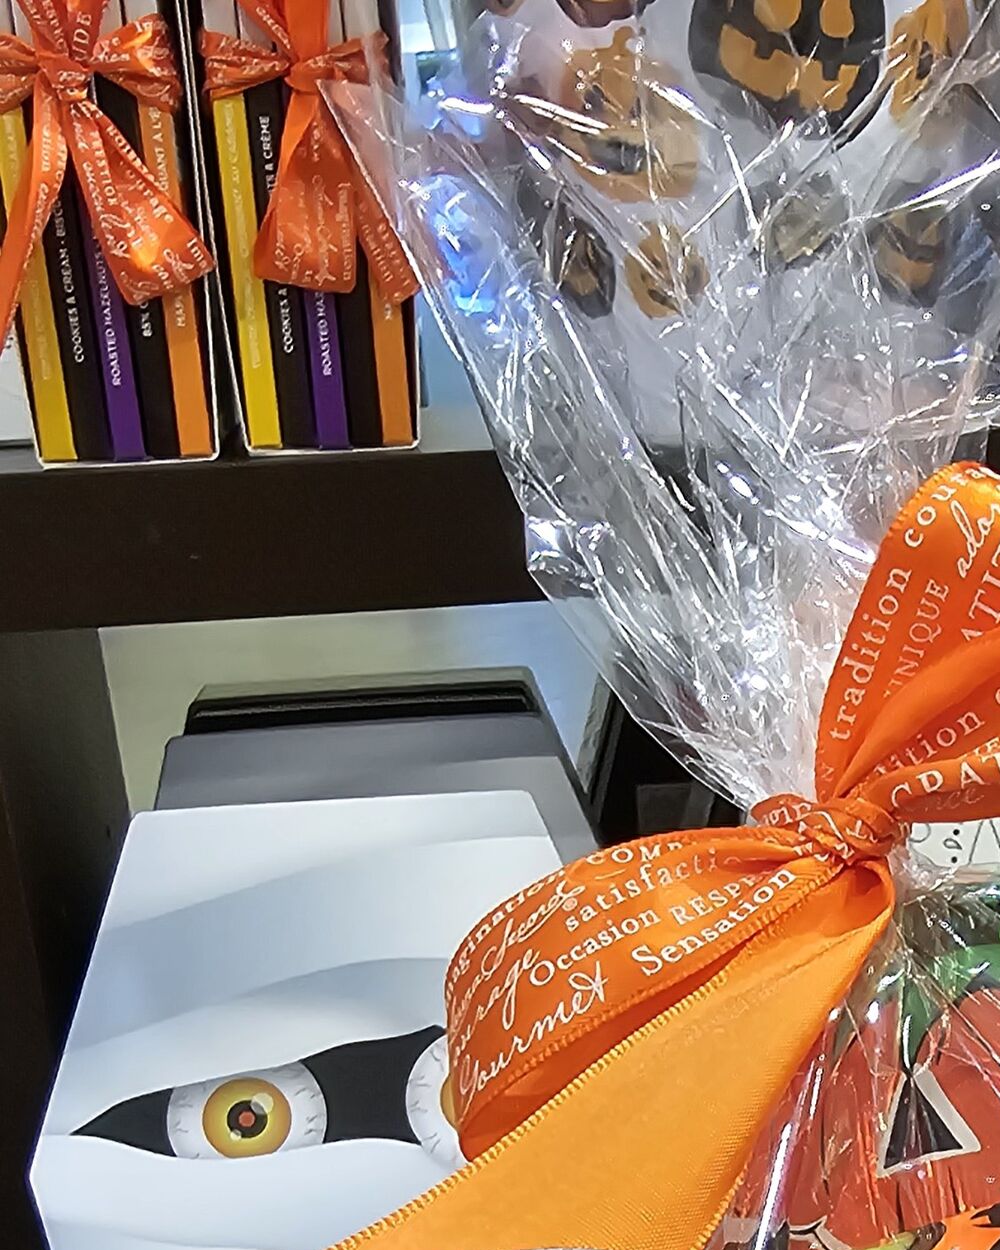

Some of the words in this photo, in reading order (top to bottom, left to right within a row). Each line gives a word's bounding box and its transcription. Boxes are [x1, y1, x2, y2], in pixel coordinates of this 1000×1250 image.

[58, 246, 75, 294] CREAM
[66, 307, 85, 364] COOKIES
[104, 329, 122, 387] ROASTED
[316, 319, 333, 377] ROASTED
[829, 566, 912, 744] tradition
[528, 905, 662, 987] Occasion
[629, 868, 799, 977] Sensation
